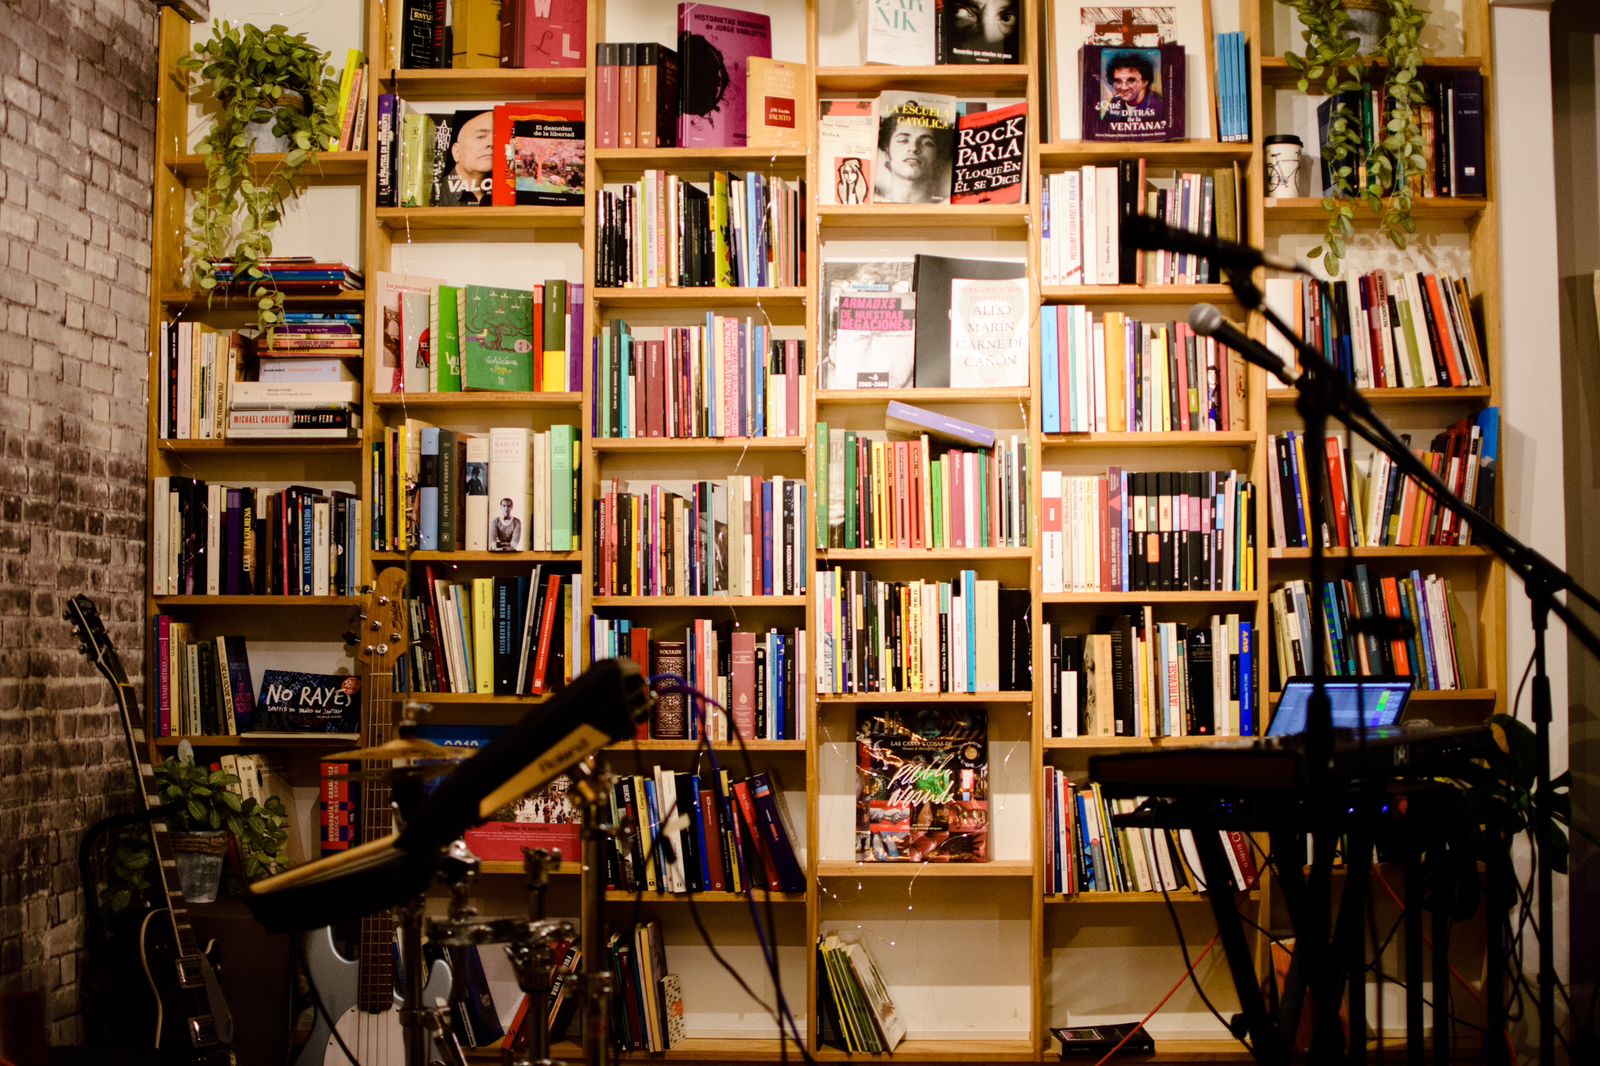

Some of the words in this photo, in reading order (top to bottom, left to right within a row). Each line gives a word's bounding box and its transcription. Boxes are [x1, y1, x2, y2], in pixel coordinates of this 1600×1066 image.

[413, 11, 433, 20] RAYU
[694, 14, 735, 25] HISTORIETAS
[714, 24, 734, 34] JORGE
[736, 26, 767, 38] VARLOTTA
[902, 105, 951, 118] ESCUELA
[1122, 108, 1155, 116] DETRÁS
[769, 114, 792, 122] FAUSTO
[897, 116, 949, 130] CATÓLICA
[1110, 120, 1167, 131] VENTANA?
[958, 117, 1023, 148] ROCK
[956, 144, 1023, 167] PARIA
[974, 179, 987, 190] SE
[990, 173, 1020, 187] DICE
[1376, 275, 1385, 301] FRANKLIN
[841, 297, 897, 310] ARMADXS
[841, 310, 853, 320] DE
[855, 310, 905, 320] NUESTRAS
[973, 304, 1011, 316] ALDO
[840, 319, 911, 330] NEGACIONES
[956, 339, 1005, 350] CARNE
[964, 353, 1017, 367] CAÑÓN
[234, 415, 260, 424] MICHAEL
[260, 415, 290, 424] CRICHTON
[293, 414, 311, 424] STATE
[318, 414, 334, 423] FEAR
[244, 508, 252, 538] COLMENA
[244, 539, 251, 549] LA
[243, 555, 251, 572] CELA
[303, 566, 310, 574] LA
[266, 684, 293, 705] NO
